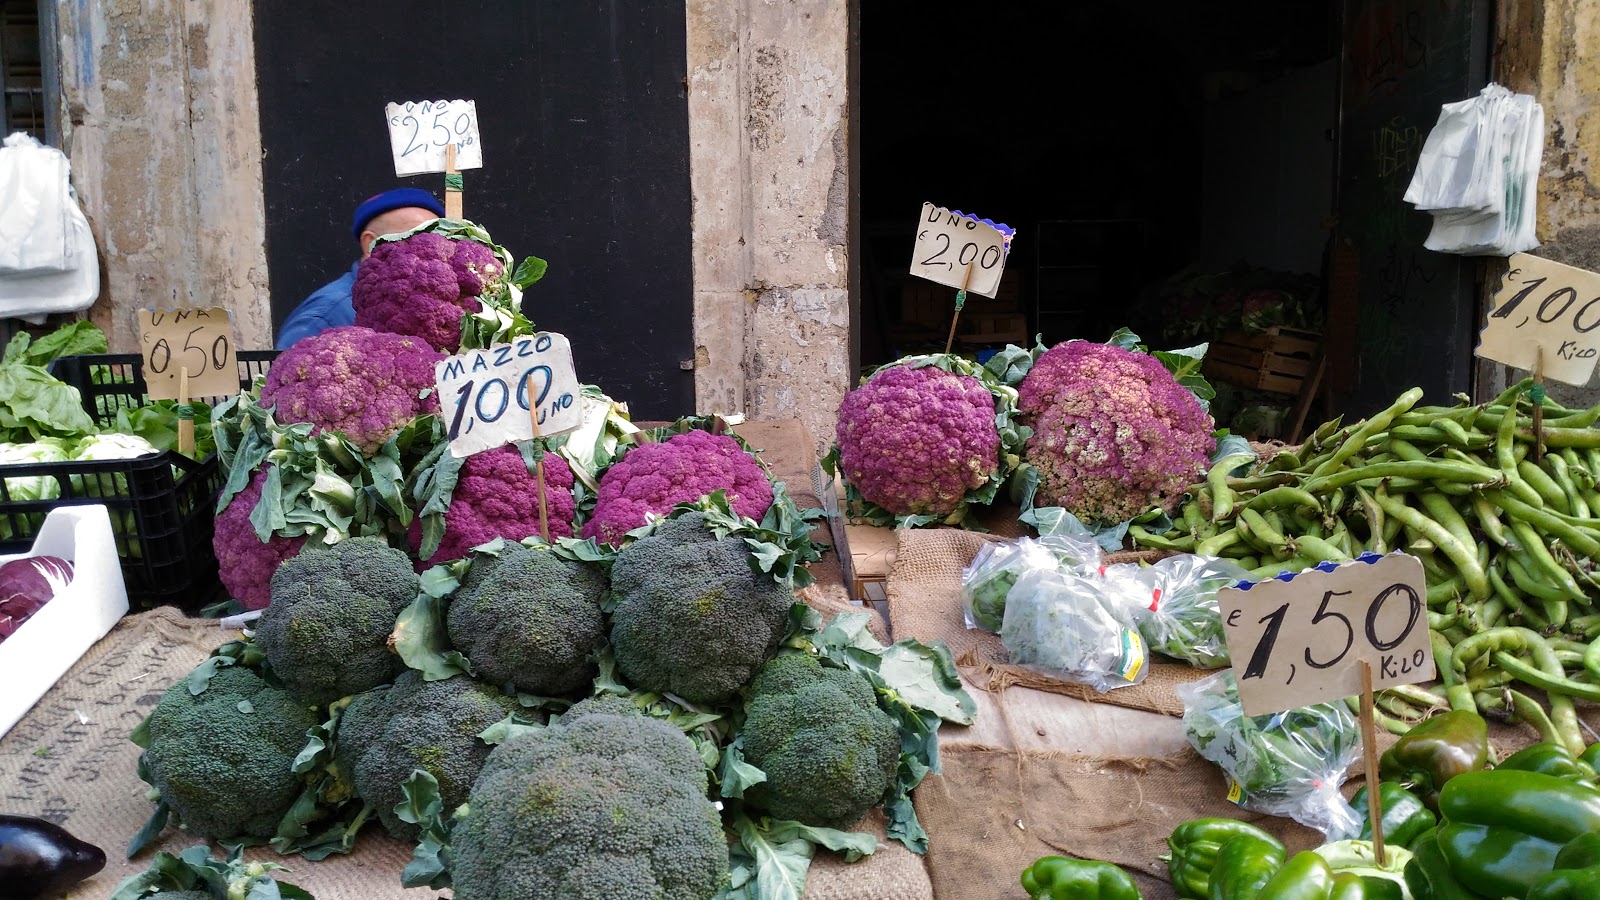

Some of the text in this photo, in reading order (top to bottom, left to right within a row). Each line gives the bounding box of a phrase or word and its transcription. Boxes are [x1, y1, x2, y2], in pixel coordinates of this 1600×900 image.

[405, 101, 447, 115] UNO
[452, 136, 474, 155] NO
[927, 206, 977, 230] UNO
[151, 309, 211, 327] UNA
[442, 335, 552, 383] MAZZO
[448, 364, 553, 443] 1,00
